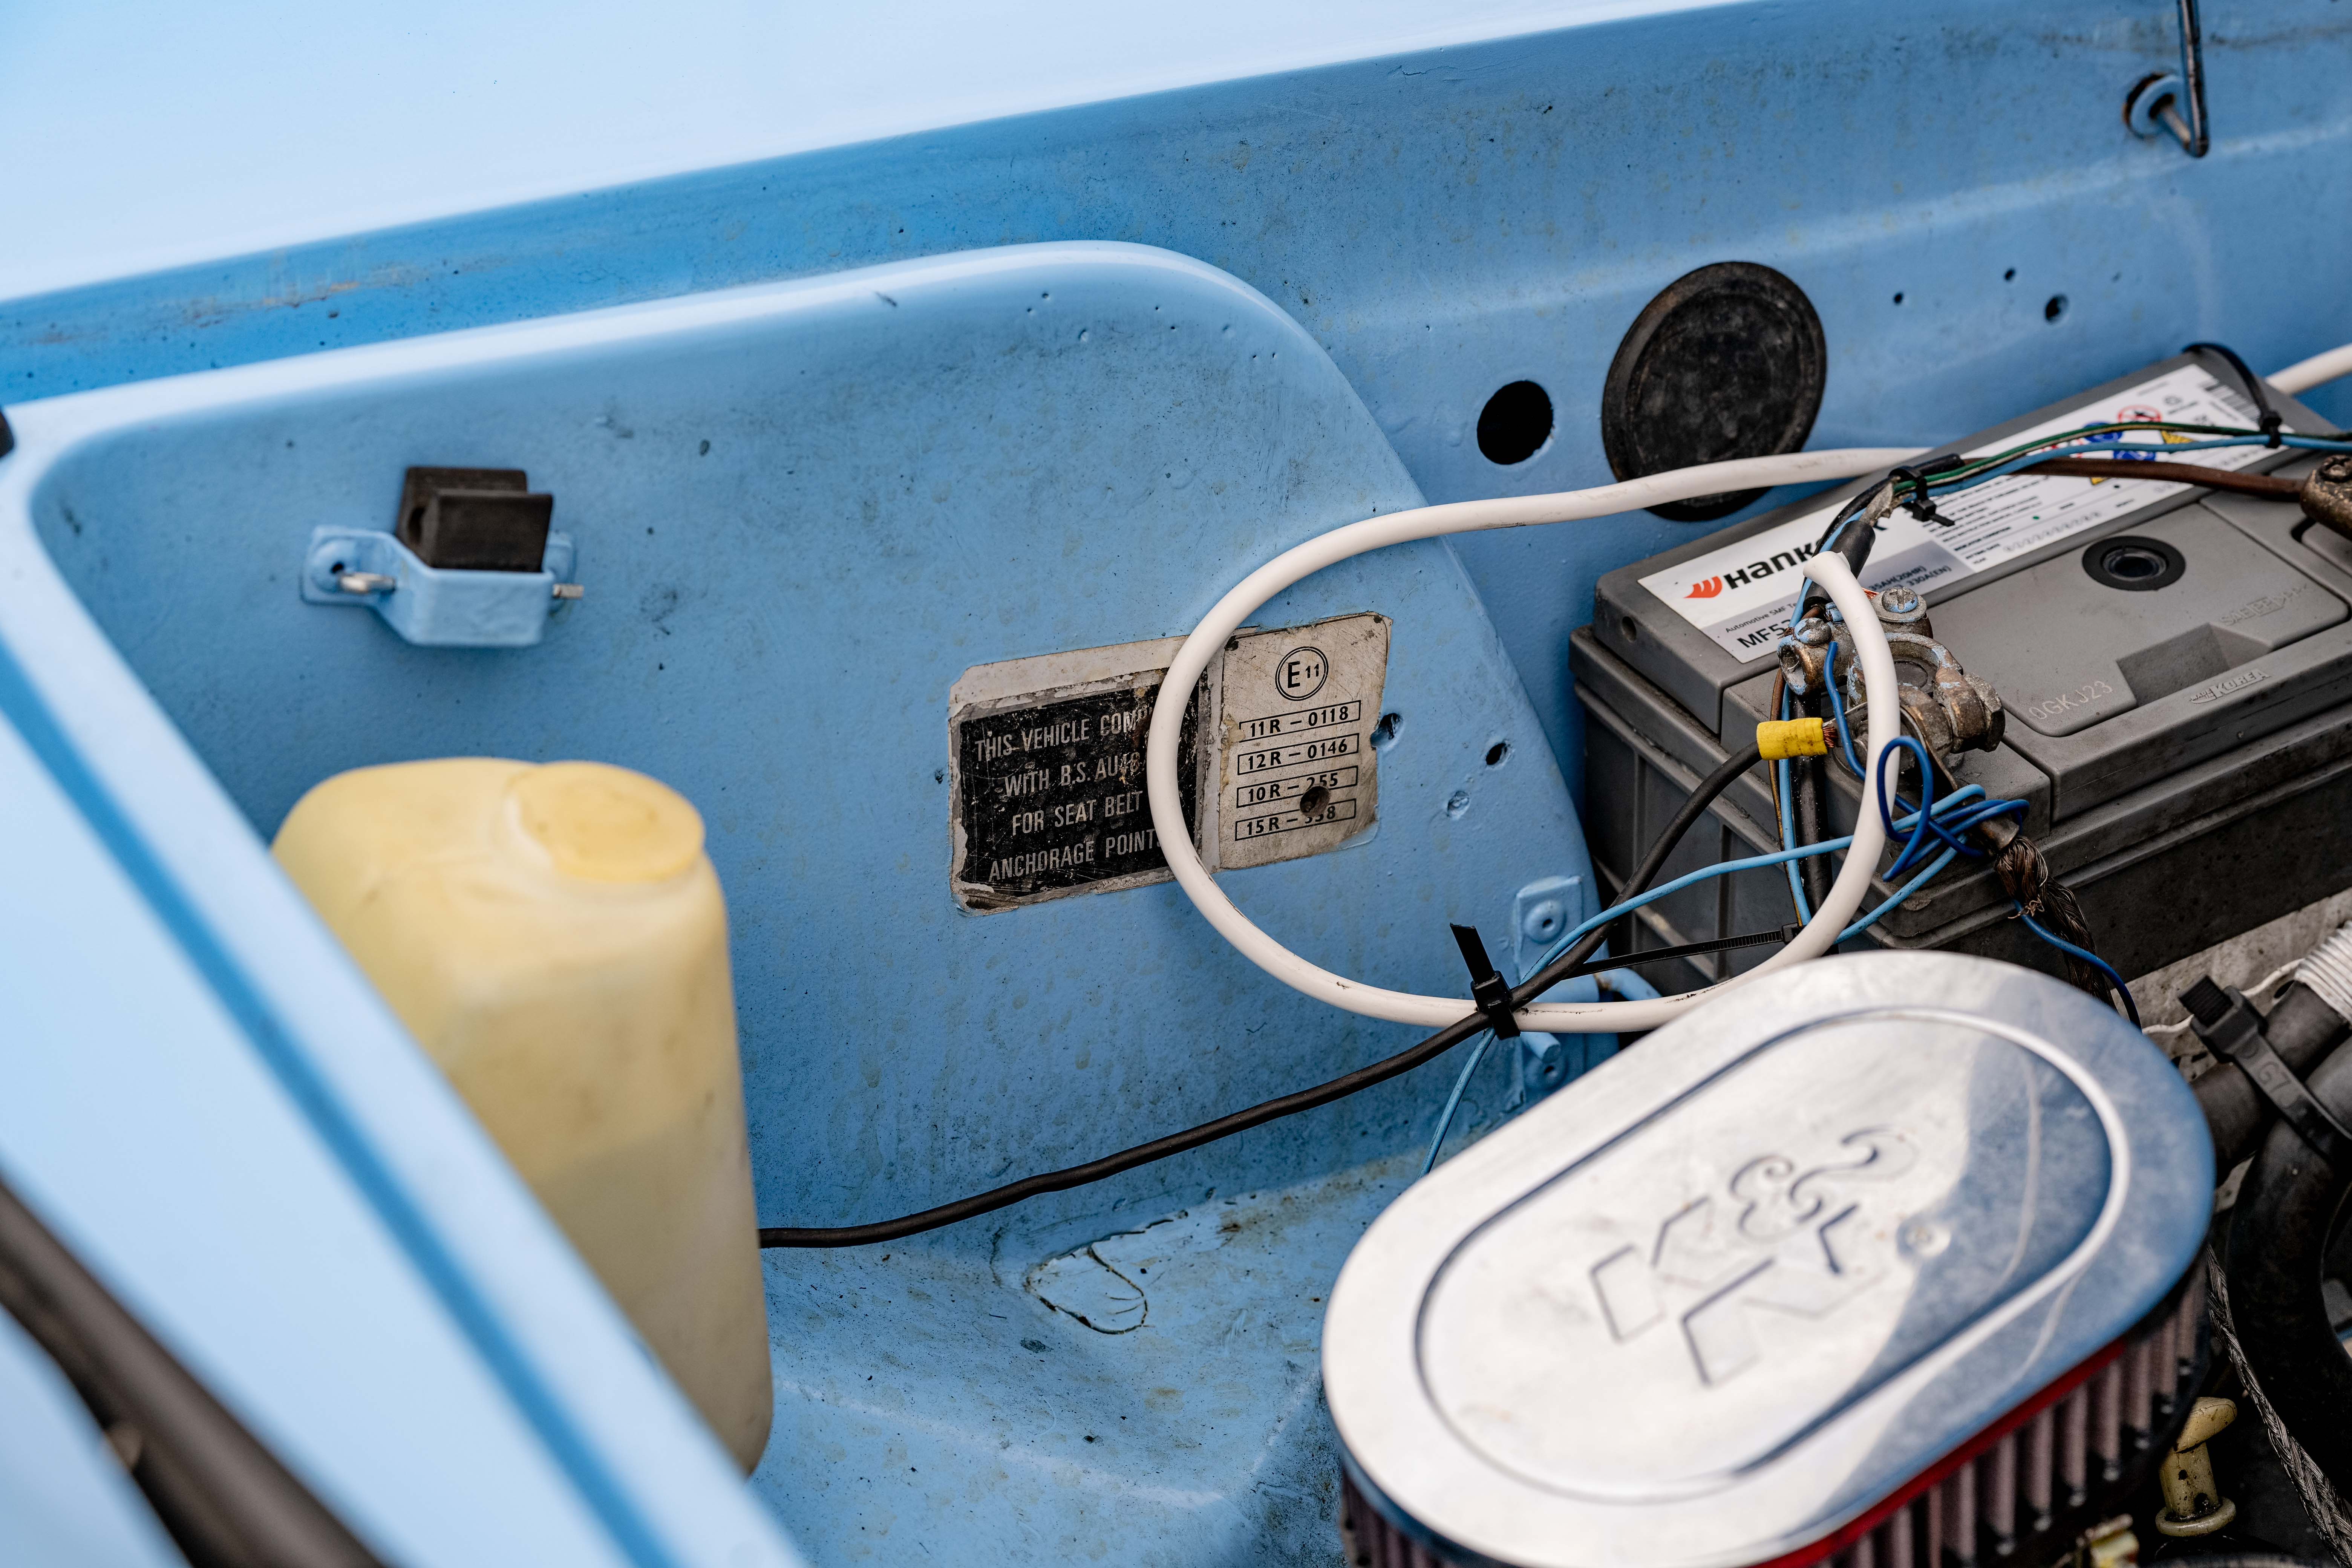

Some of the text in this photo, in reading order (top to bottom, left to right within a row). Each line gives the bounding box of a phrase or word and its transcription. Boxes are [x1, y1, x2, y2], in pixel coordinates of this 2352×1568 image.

[1723, 538, 1822, 589] Hank
[1726, 614, 1769, 633] Automotive
[1770, 606, 1786, 615] SMF
[2210, 668, 2272, 698] KOREA
[975, 734, 1012, 761] THIS
[1022, 718, 1089, 751] VEHICLE
[1004, 769, 1049, 797] WITH
[1061, 762, 1091, 786] B.S.
[1012, 790, 1143, 836] FOR SEAT BELT
[989, 841, 1094, 882] ANCHORAGE
